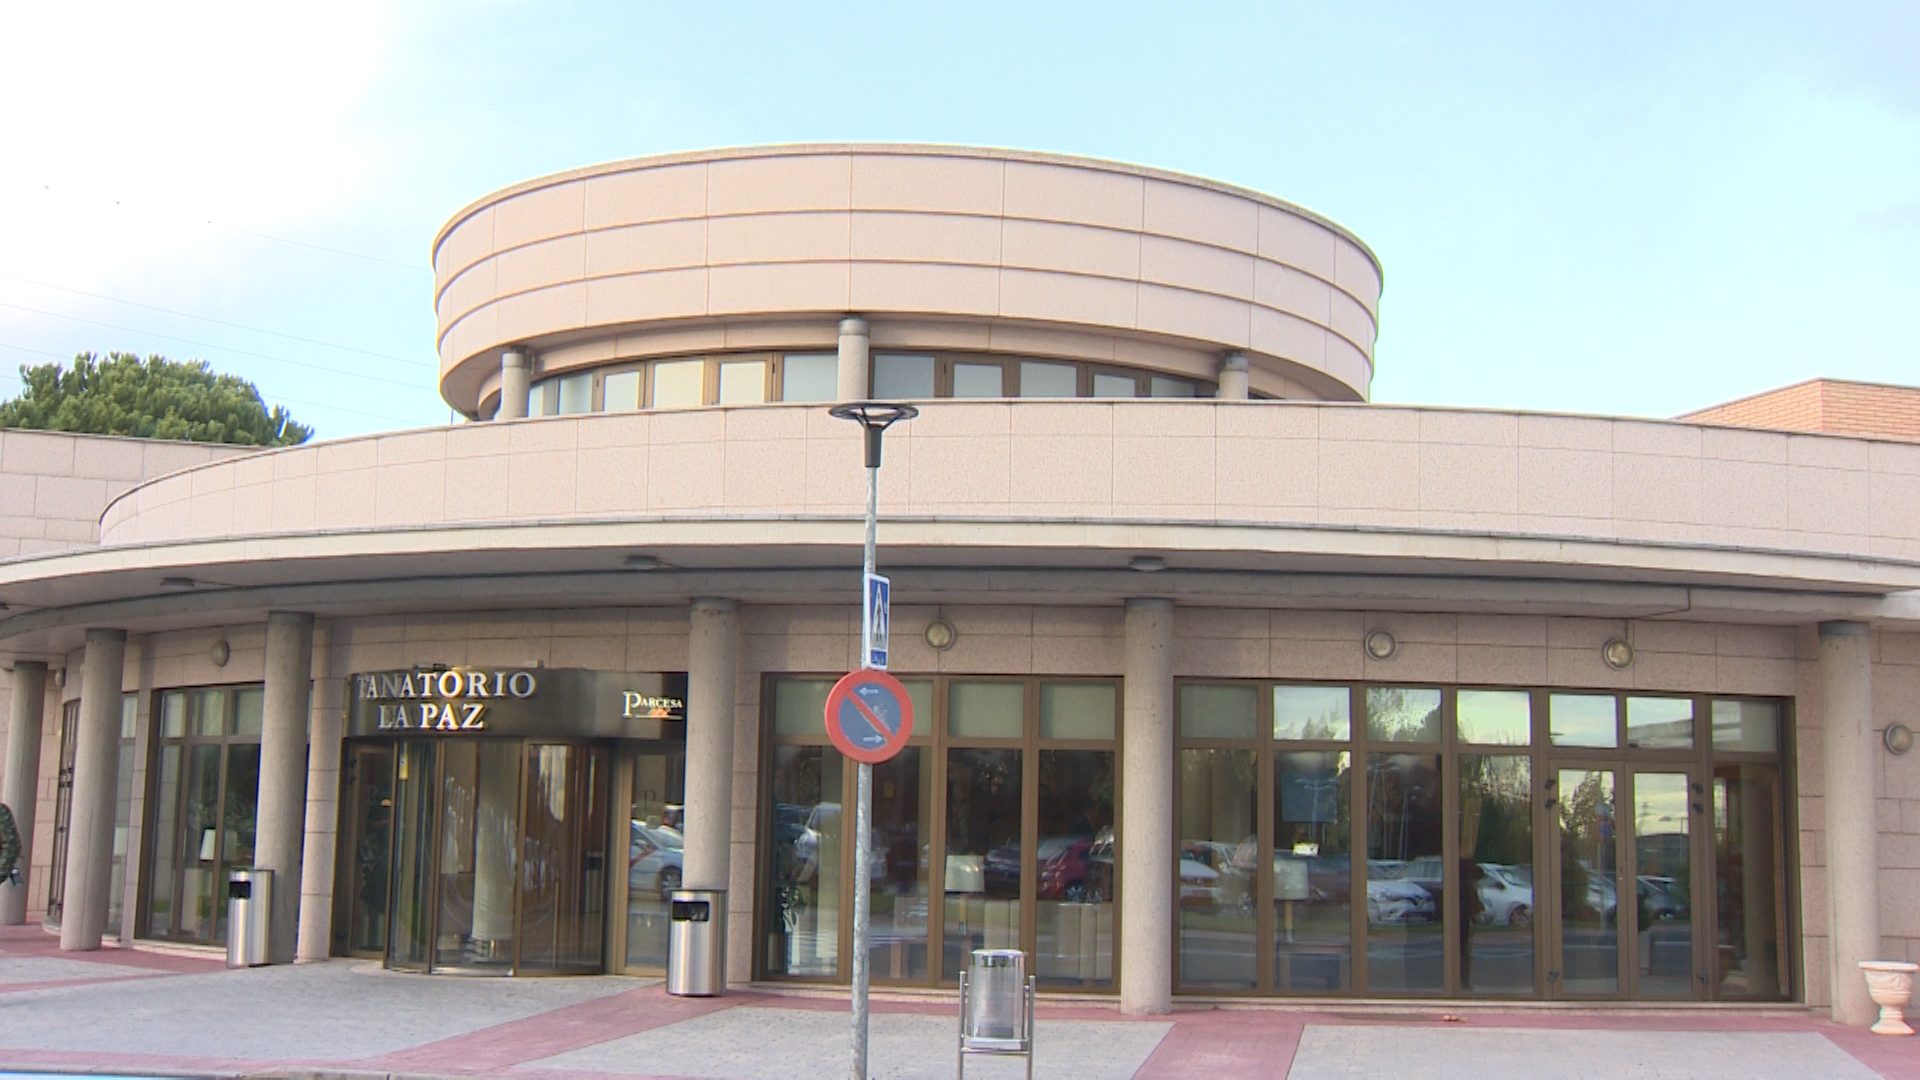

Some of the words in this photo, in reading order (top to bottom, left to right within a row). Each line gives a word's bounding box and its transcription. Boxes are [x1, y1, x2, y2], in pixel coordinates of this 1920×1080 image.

[357, 671, 536, 699] TANATORIO
[378, 704, 412, 729] LA
[419, 702, 485, 730] PAZ
